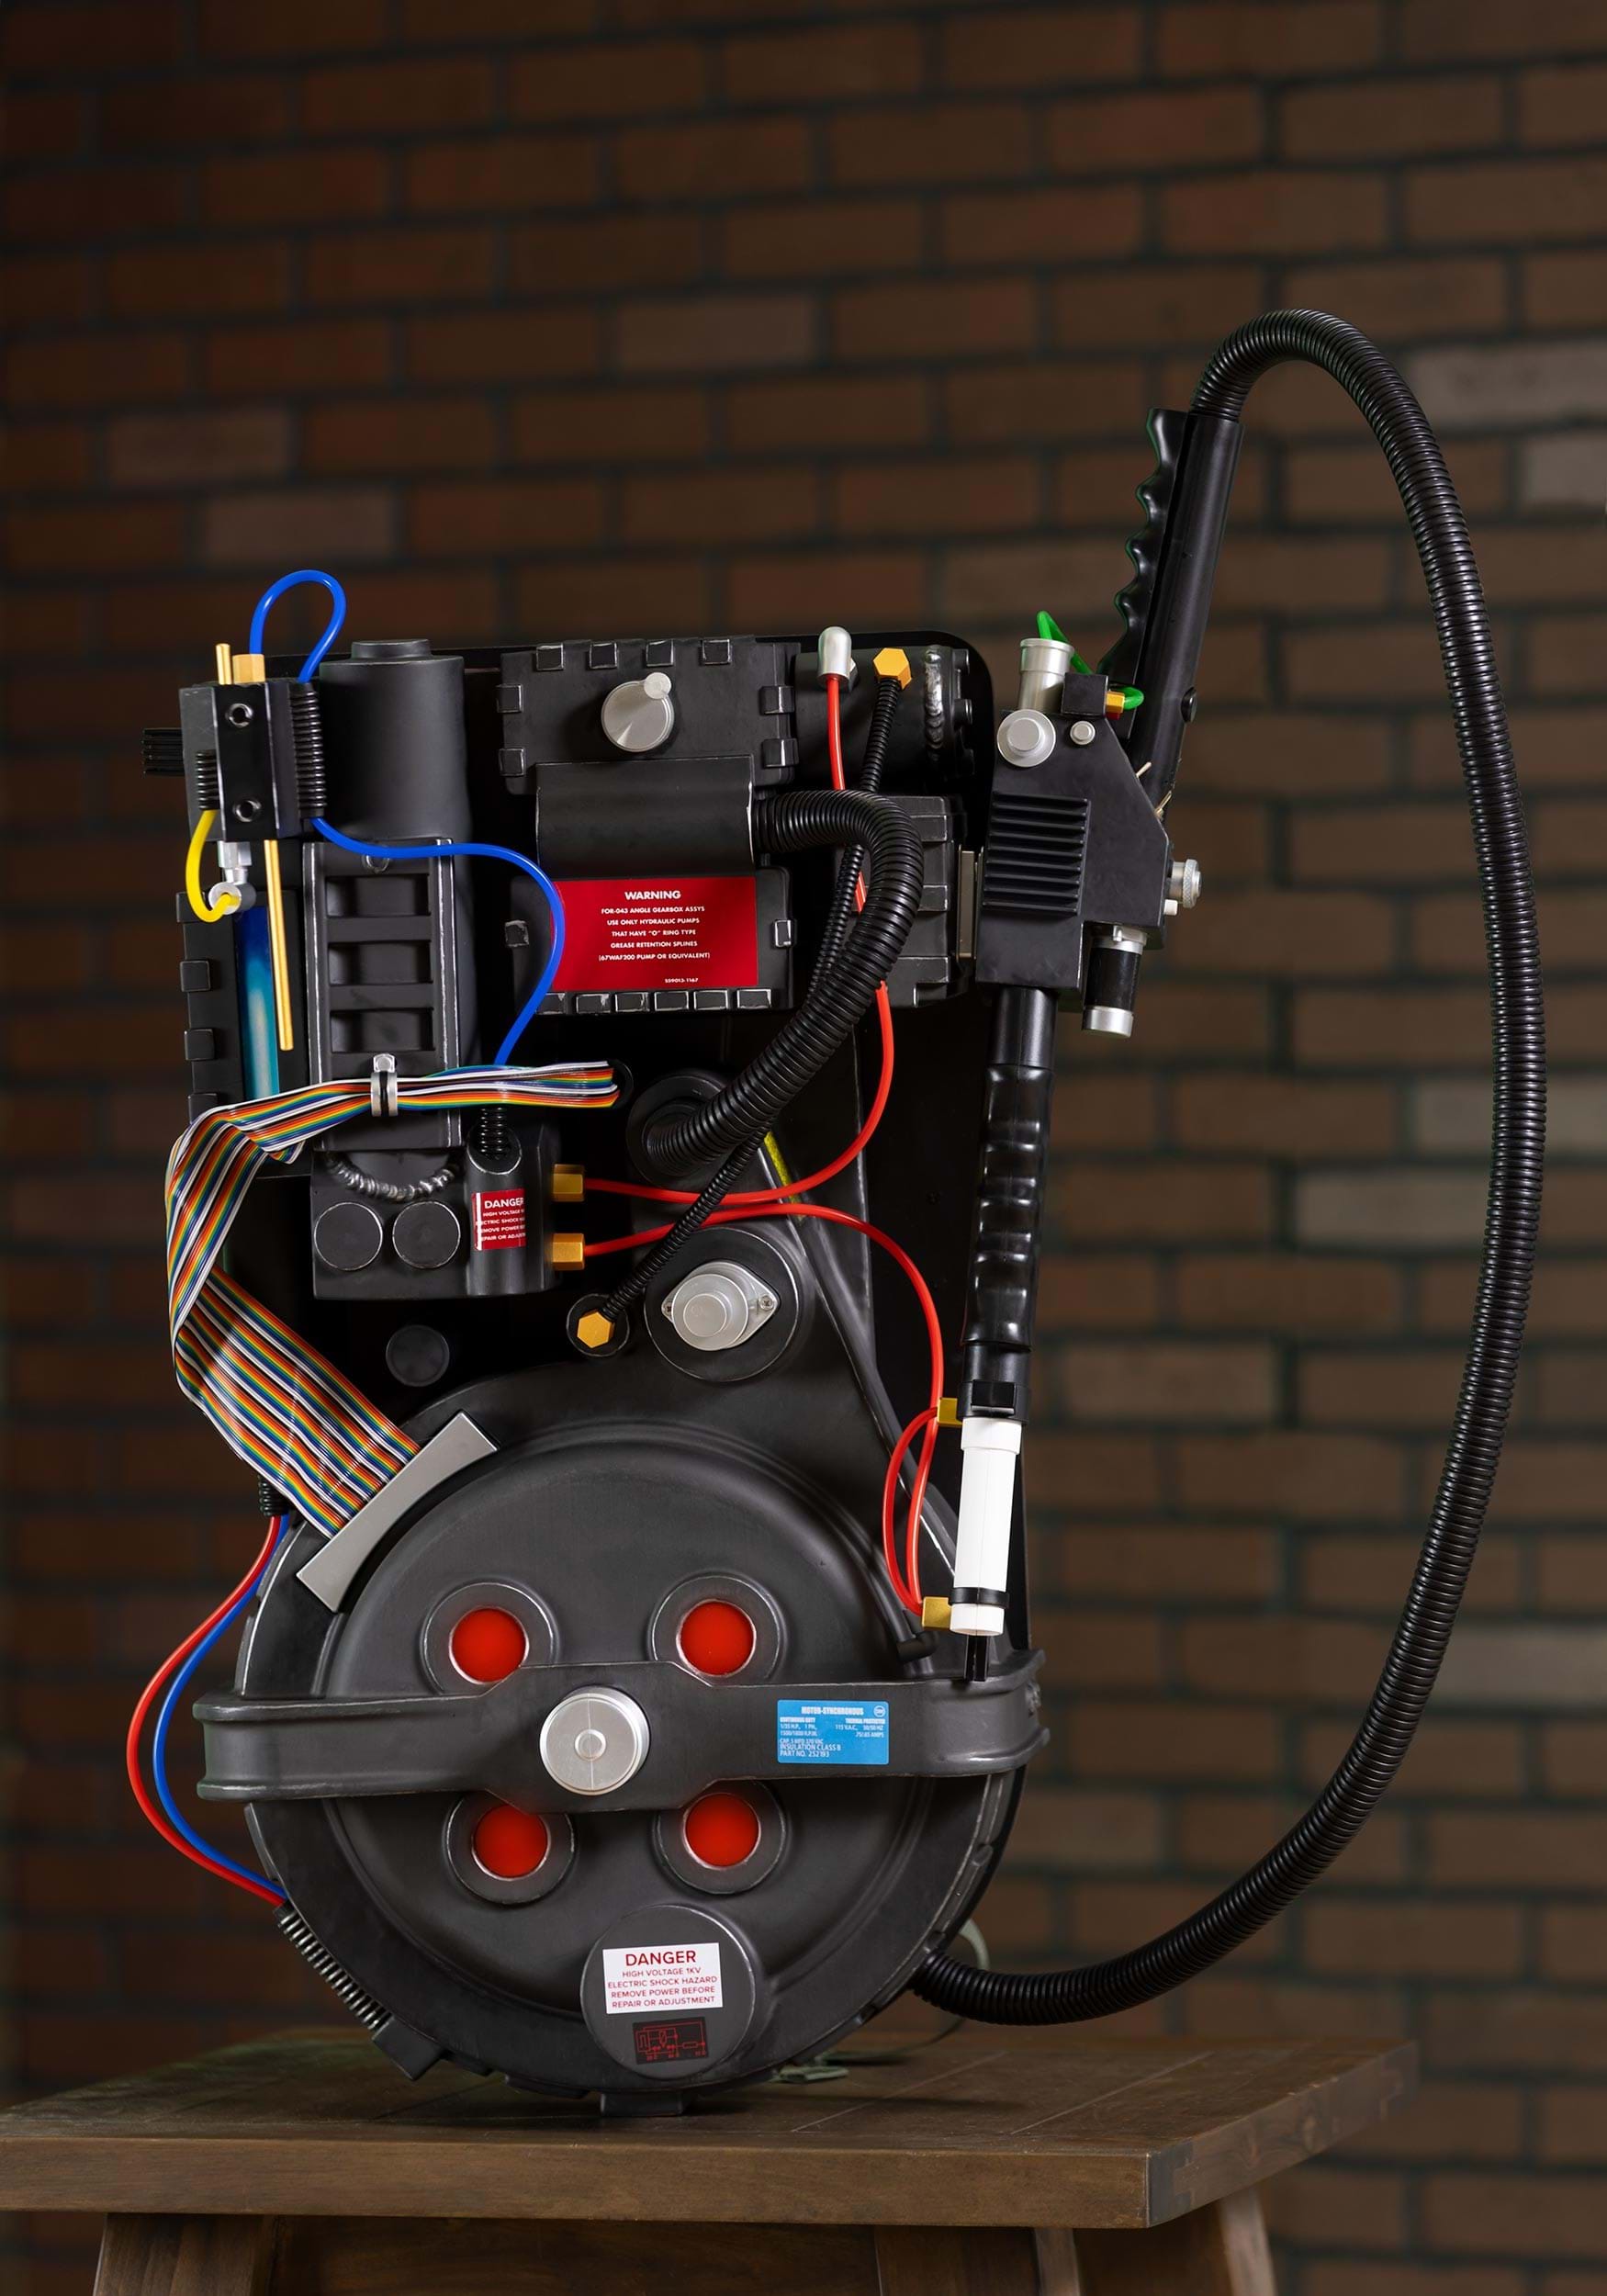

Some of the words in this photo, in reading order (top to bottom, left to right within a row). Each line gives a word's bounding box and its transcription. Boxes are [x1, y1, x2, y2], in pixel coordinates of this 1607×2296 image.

[624, 890, 681, 900] WARNING
[625, 1950, 697, 1966] DANGER
[622, 1970, 643, 1978] HIGH
[646, 1967, 684, 1976] VOLTAGE
[686, 1966, 702, 1975] 1KV
[608, 1979, 647, 1989] ELECTRIC
[649, 1977, 680, 1986] SHOCK
[681, 1975, 718, 1985] HAZARD
[611, 1989, 646, 1998] REMOVE
[649, 1987, 680, 1997] POWER
[681, 1986, 715, 1995] BEFORE
[612, 1999, 642, 2009] REPAIR
[644, 1998, 657, 2007] OR
[658, 1996, 715, 2006] ADJUSTMENT
